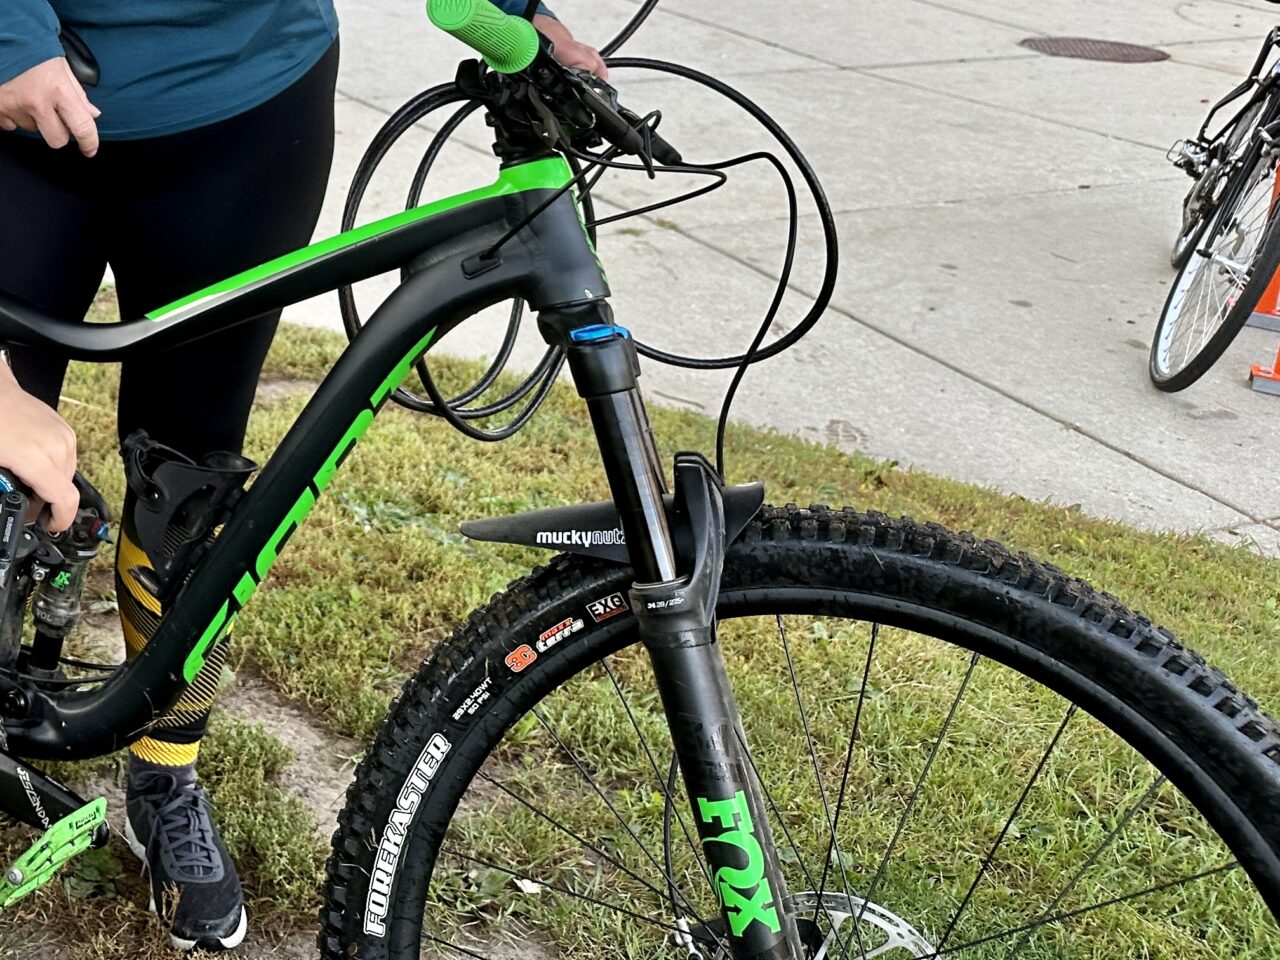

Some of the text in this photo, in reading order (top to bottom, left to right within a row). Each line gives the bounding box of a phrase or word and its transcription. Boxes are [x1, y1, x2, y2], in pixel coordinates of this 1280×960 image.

[536, 619, 584, 653] terra
[364, 733, 452, 938] FOREKASTER
[697, 790, 781, 938] FOX
